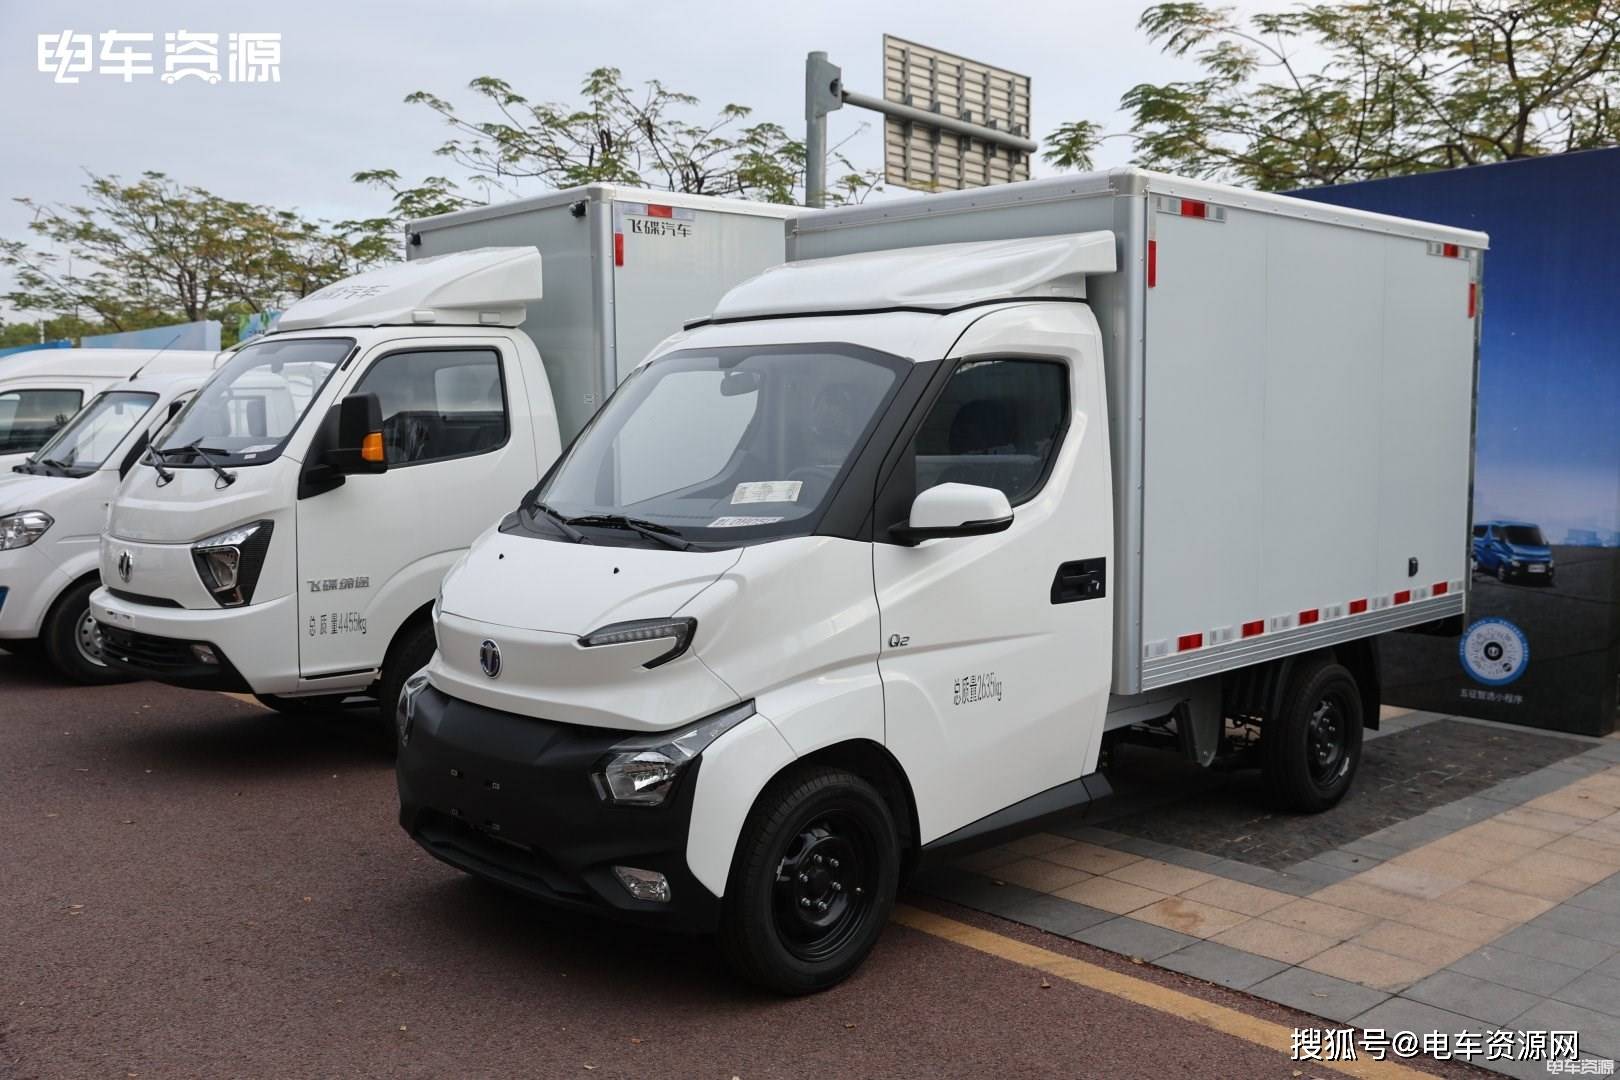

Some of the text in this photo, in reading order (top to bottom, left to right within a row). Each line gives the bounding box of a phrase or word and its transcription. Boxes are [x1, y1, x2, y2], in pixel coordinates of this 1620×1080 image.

[625, 218, 693, 237] 飞碟汽车
[887, 633, 910, 648] Q2
[953, 672, 1002, 705] 总质量2635kg
